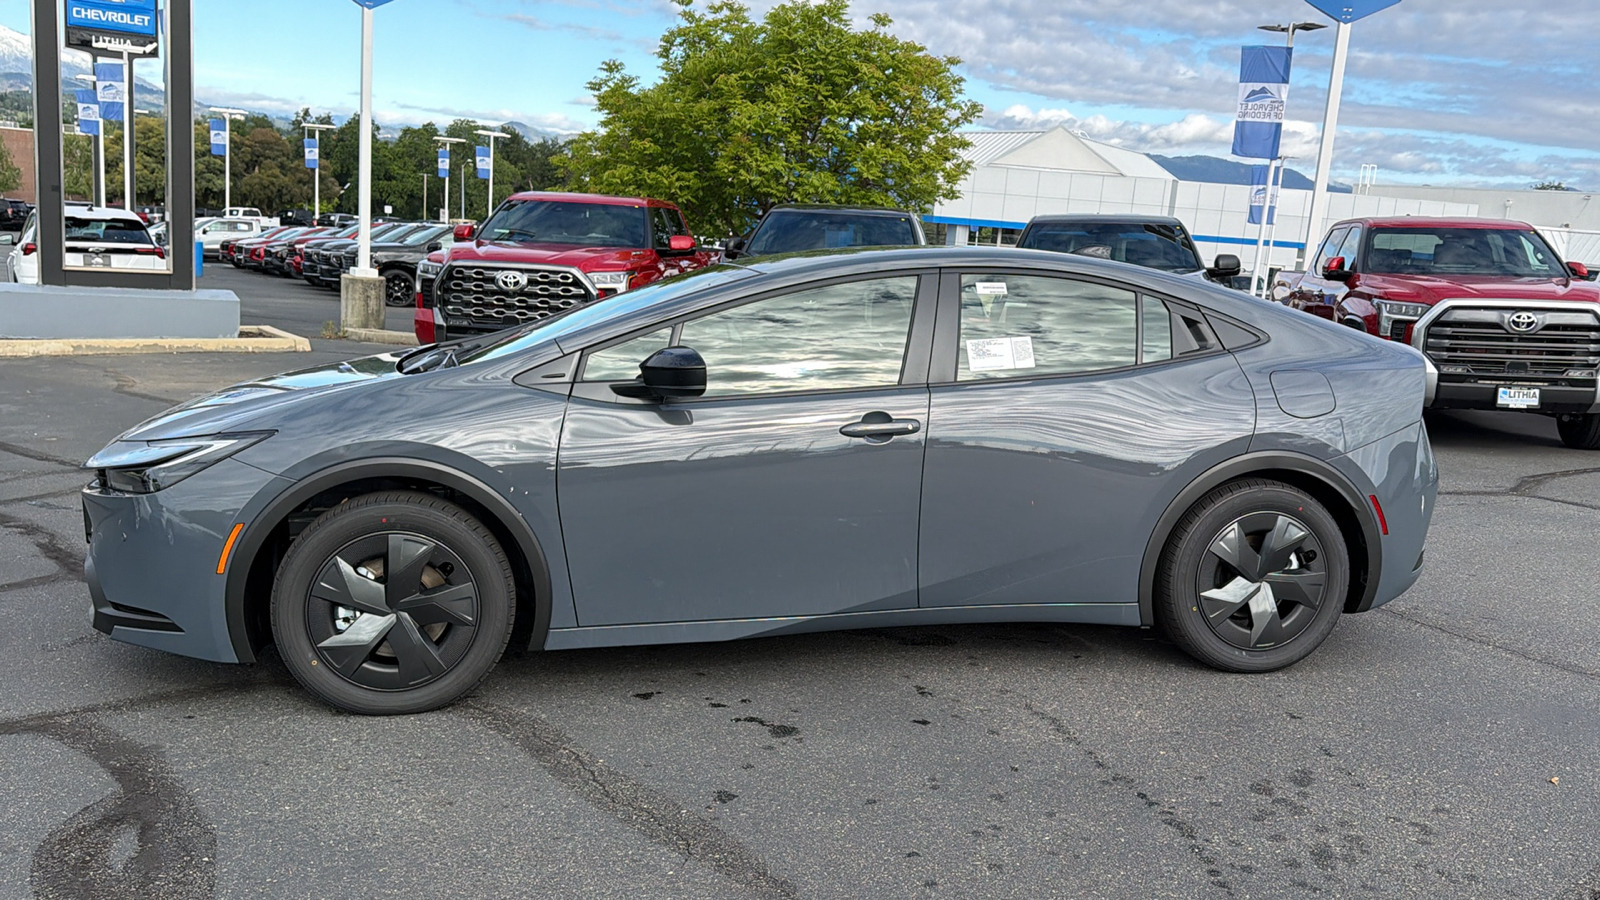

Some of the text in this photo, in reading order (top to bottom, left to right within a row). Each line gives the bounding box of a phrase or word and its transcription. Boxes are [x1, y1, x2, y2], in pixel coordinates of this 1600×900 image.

[72, 7, 151, 26] CHEVROLET
[92, 35, 133, 47] LITHIA
[1508, 390, 1537, 399] LITHIA
